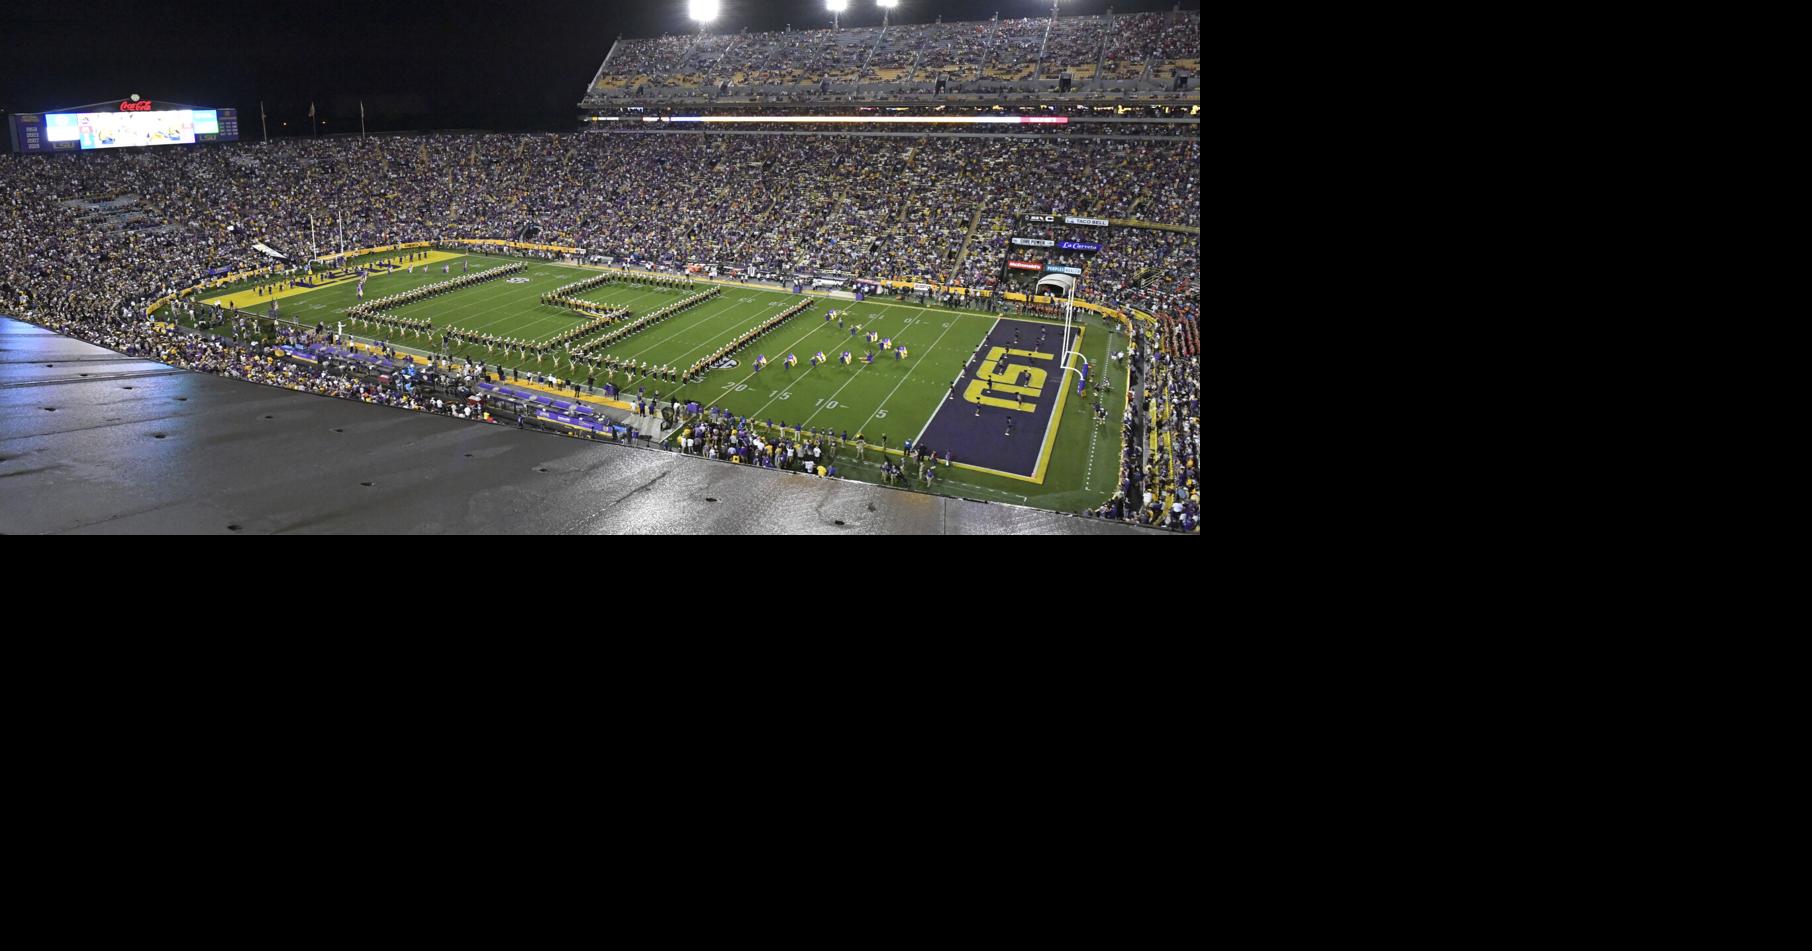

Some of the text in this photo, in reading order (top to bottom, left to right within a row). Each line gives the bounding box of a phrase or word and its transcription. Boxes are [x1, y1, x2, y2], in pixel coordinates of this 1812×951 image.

[1073, 242, 1097, 250] Carreta
[1009, 262, 1041, 270] McDonald's
[963, 346, 1055, 413] LSU
[721, 382, 748, 391] 20
[769, 390, 792, 400] 15
[815, 398, 839, 409] 10
[876, 409, 888, 419] 5
